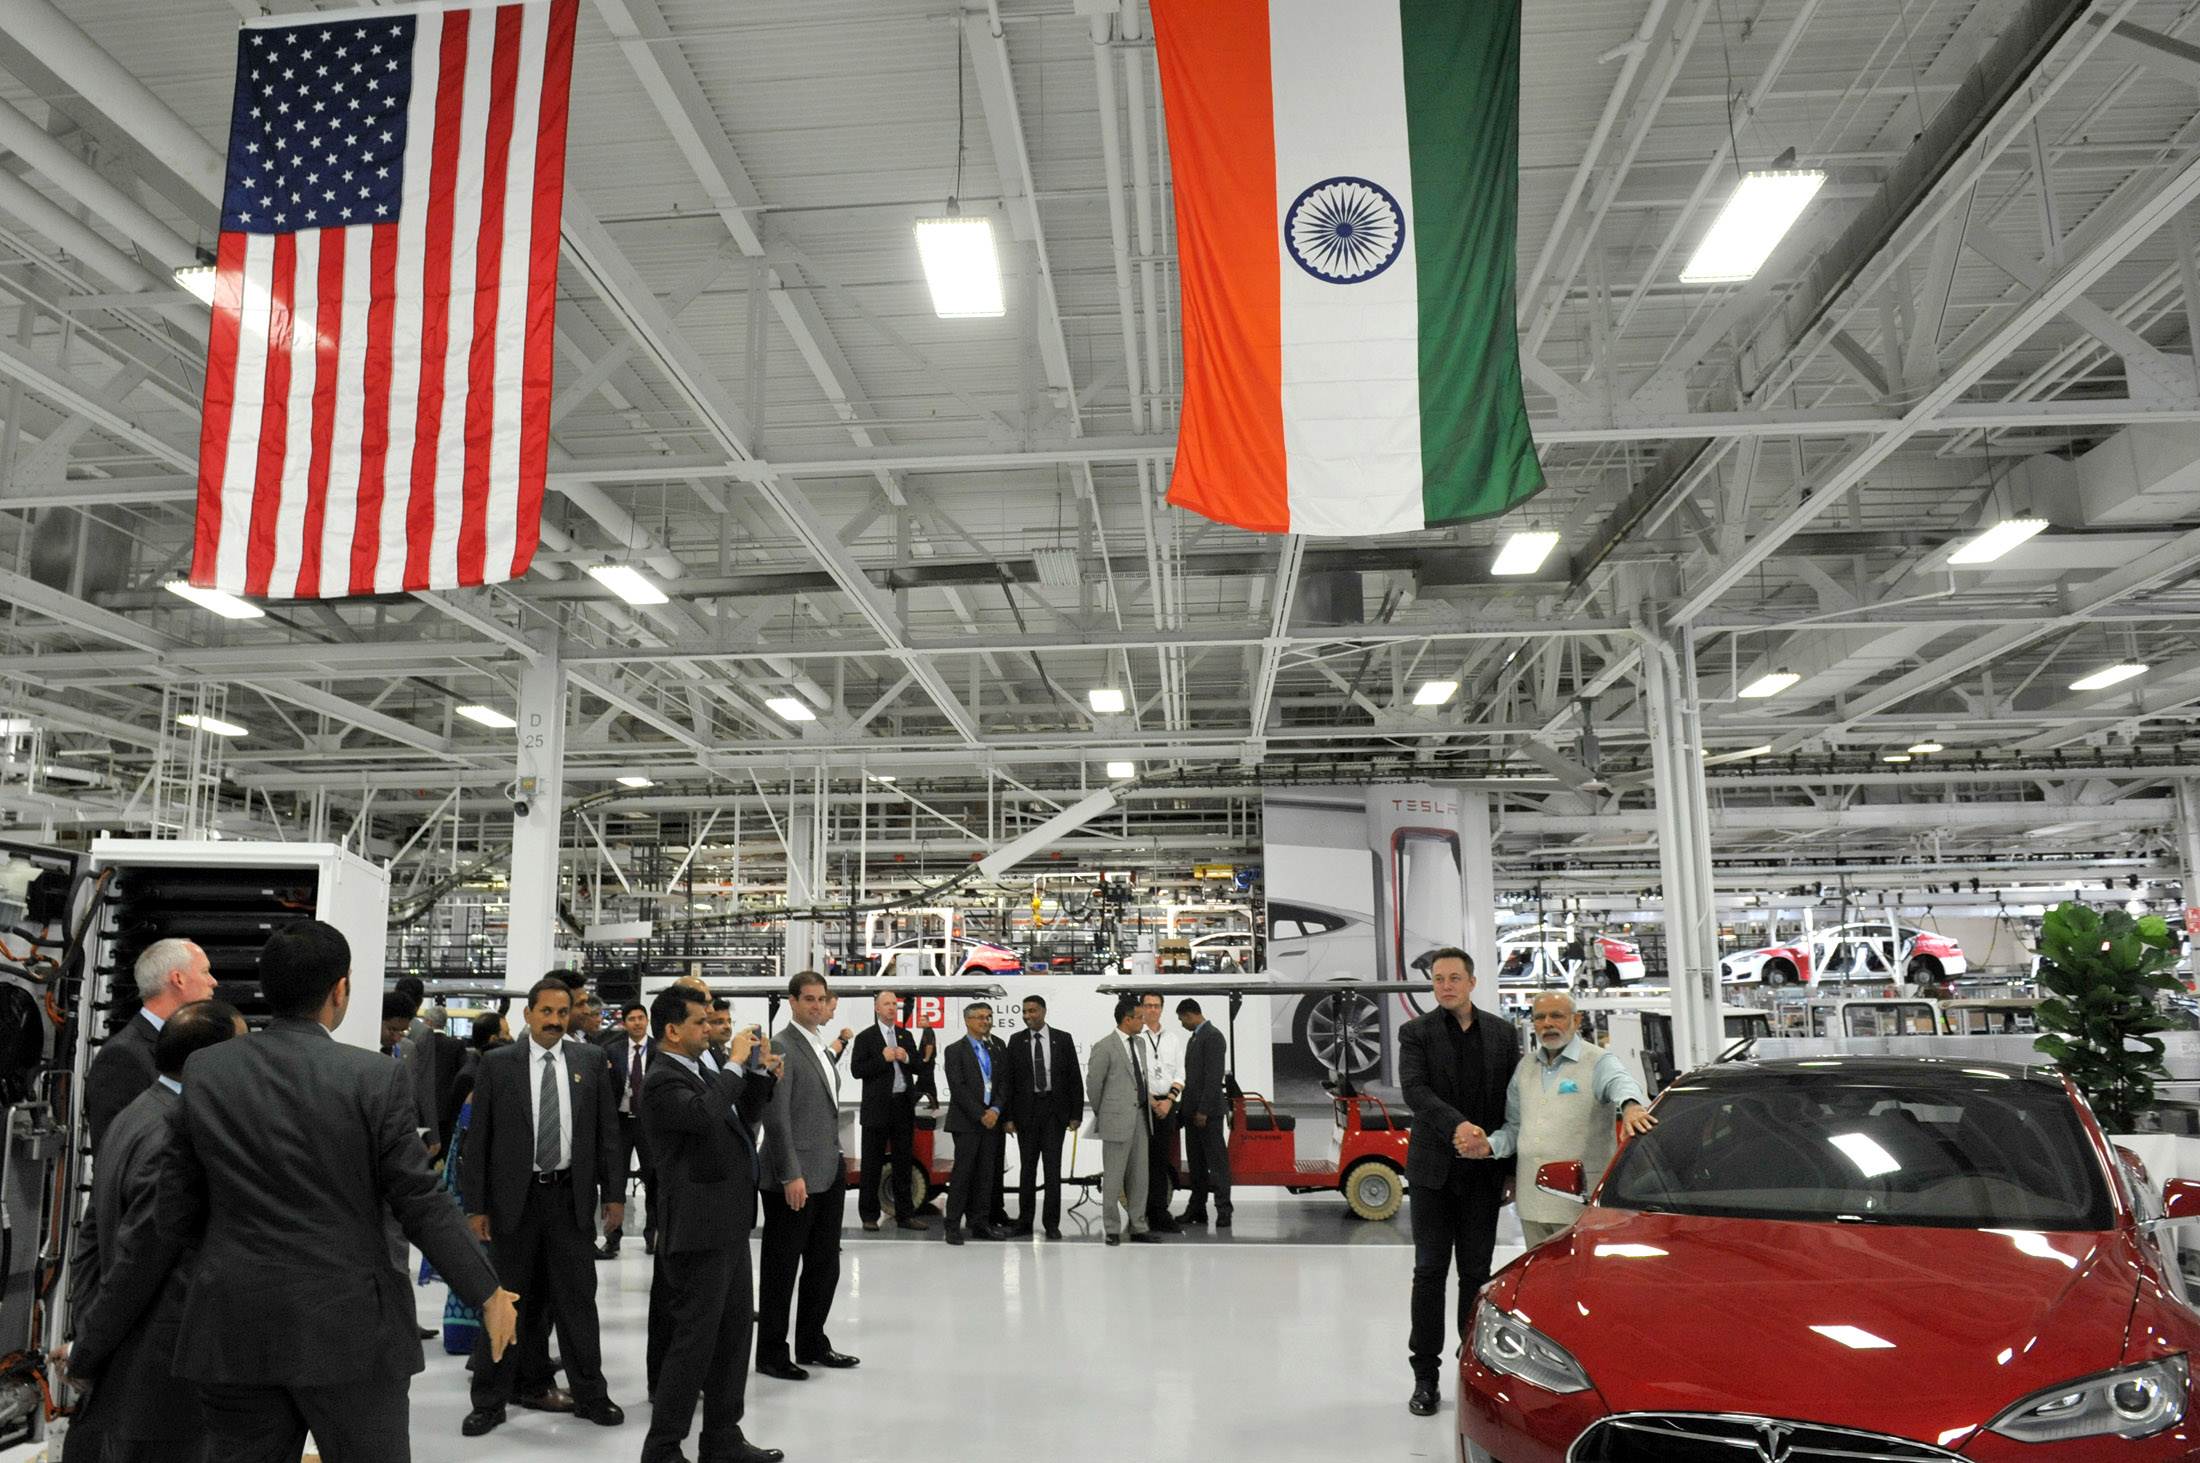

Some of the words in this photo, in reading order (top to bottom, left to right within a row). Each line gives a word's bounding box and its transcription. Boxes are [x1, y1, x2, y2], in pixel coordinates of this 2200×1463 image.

[530, 713, 541, 727] D
[525, 735, 544, 748] 25
[1392, 800, 1458, 815] TESLA
